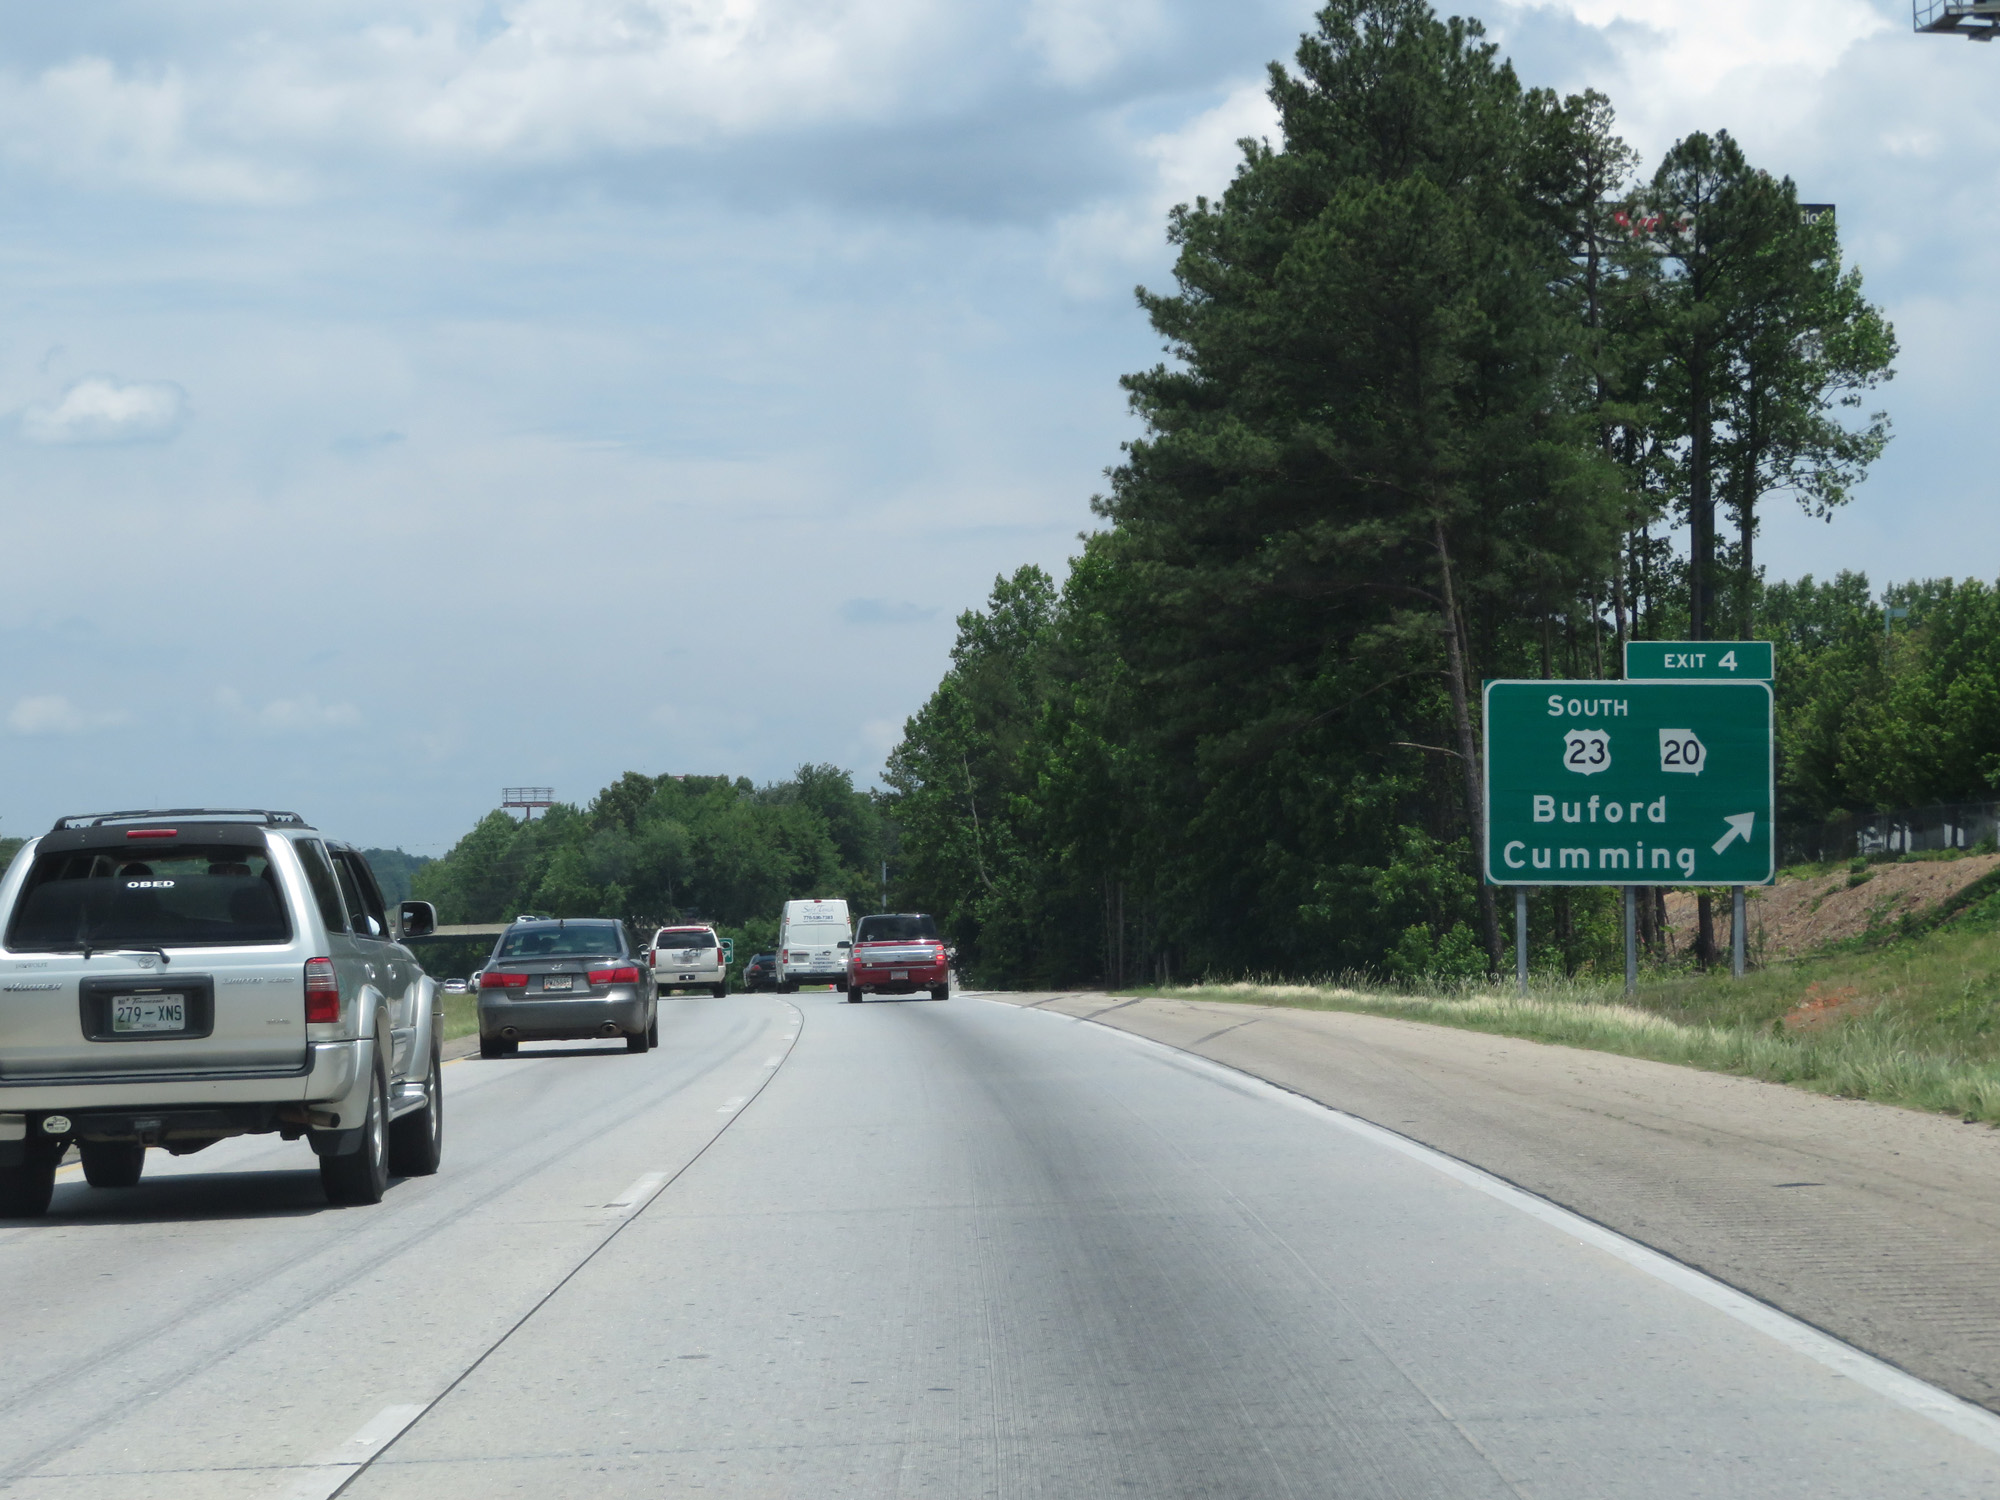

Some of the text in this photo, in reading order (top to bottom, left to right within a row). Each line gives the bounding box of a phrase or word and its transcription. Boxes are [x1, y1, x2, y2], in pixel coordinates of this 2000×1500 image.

[1664, 651, 1738, 671] EXIT 4
[1547, 694, 1629, 717] SOUTH
[1569, 739, 1606, 765] 23
[1664, 740, 1700, 765] 20
[1533, 795, 1666, 823] Buford
[1503, 840, 1695, 878] Cumming
[127, 880, 175, 888] OBED
